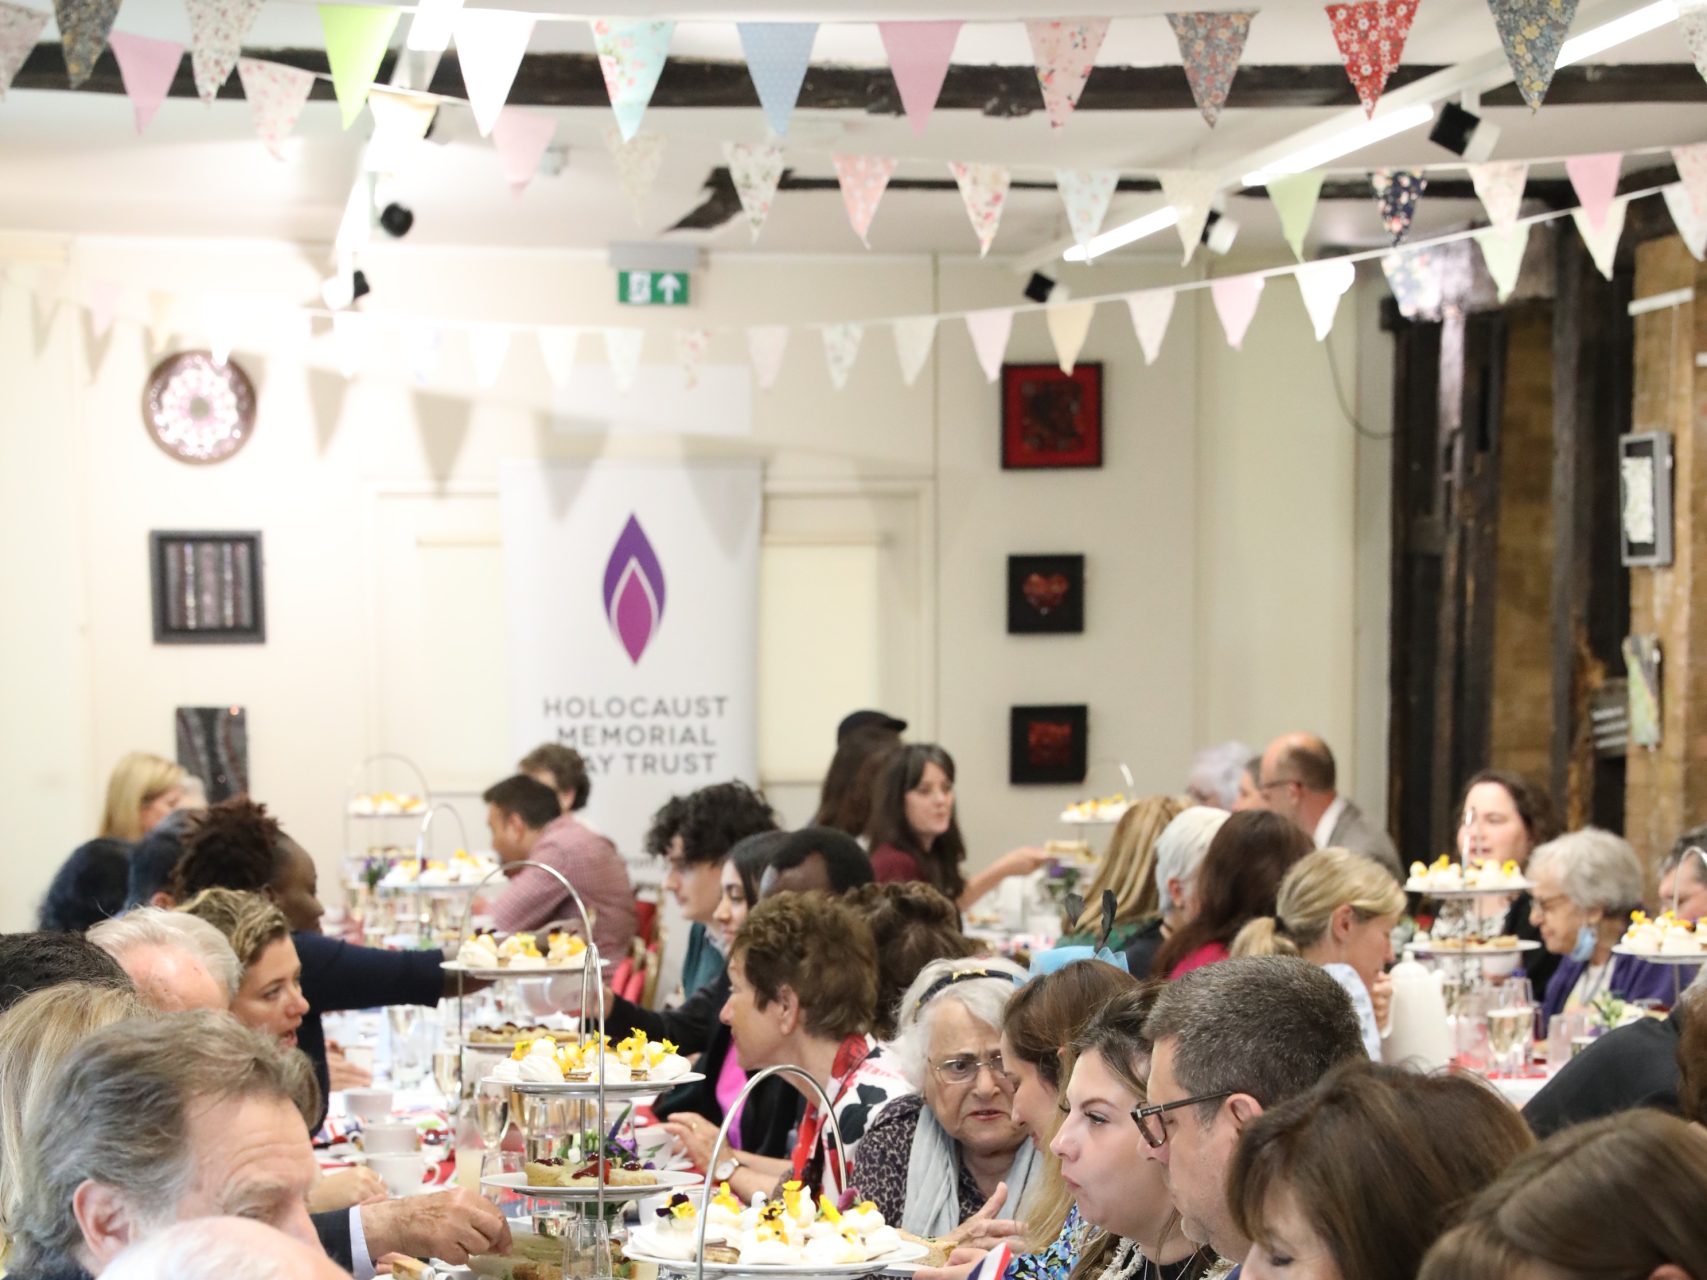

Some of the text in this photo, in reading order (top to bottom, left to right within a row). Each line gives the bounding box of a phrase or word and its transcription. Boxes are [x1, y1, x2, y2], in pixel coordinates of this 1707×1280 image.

[544, 697, 728, 718] HOLOCAUST
[557, 725, 716, 746] MEMORIAL
[583, 753, 716, 775] AY TRUST
